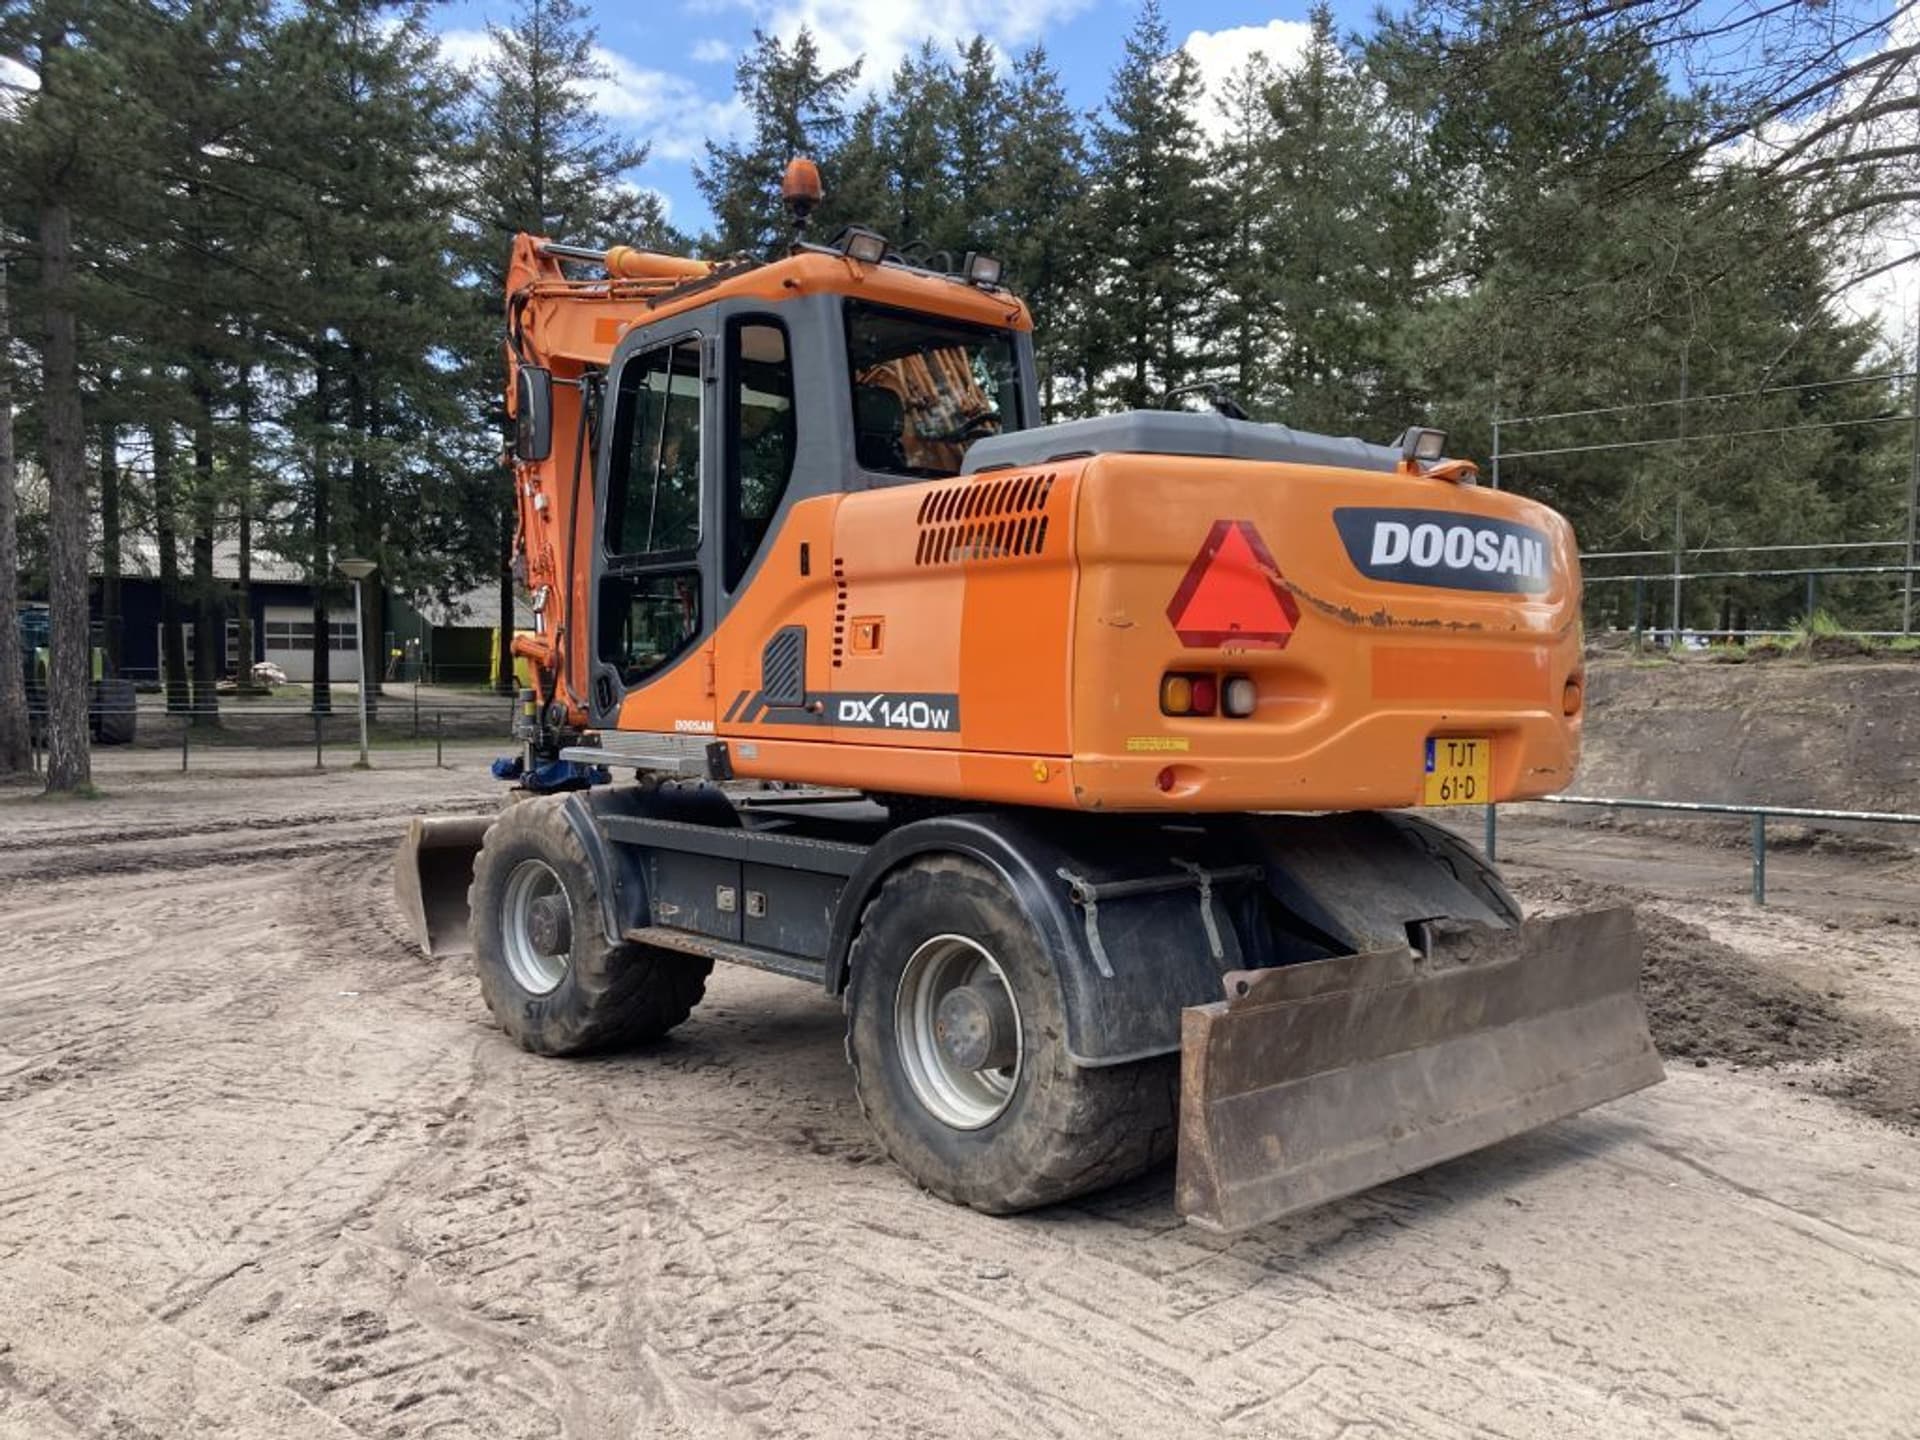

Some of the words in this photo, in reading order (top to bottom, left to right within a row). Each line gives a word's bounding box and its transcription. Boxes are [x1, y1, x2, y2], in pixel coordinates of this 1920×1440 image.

[1370, 521, 1543, 578] DOOSAN
[1447, 742, 1477, 768] TJT
[1440, 775, 1476, 801] 61-D
